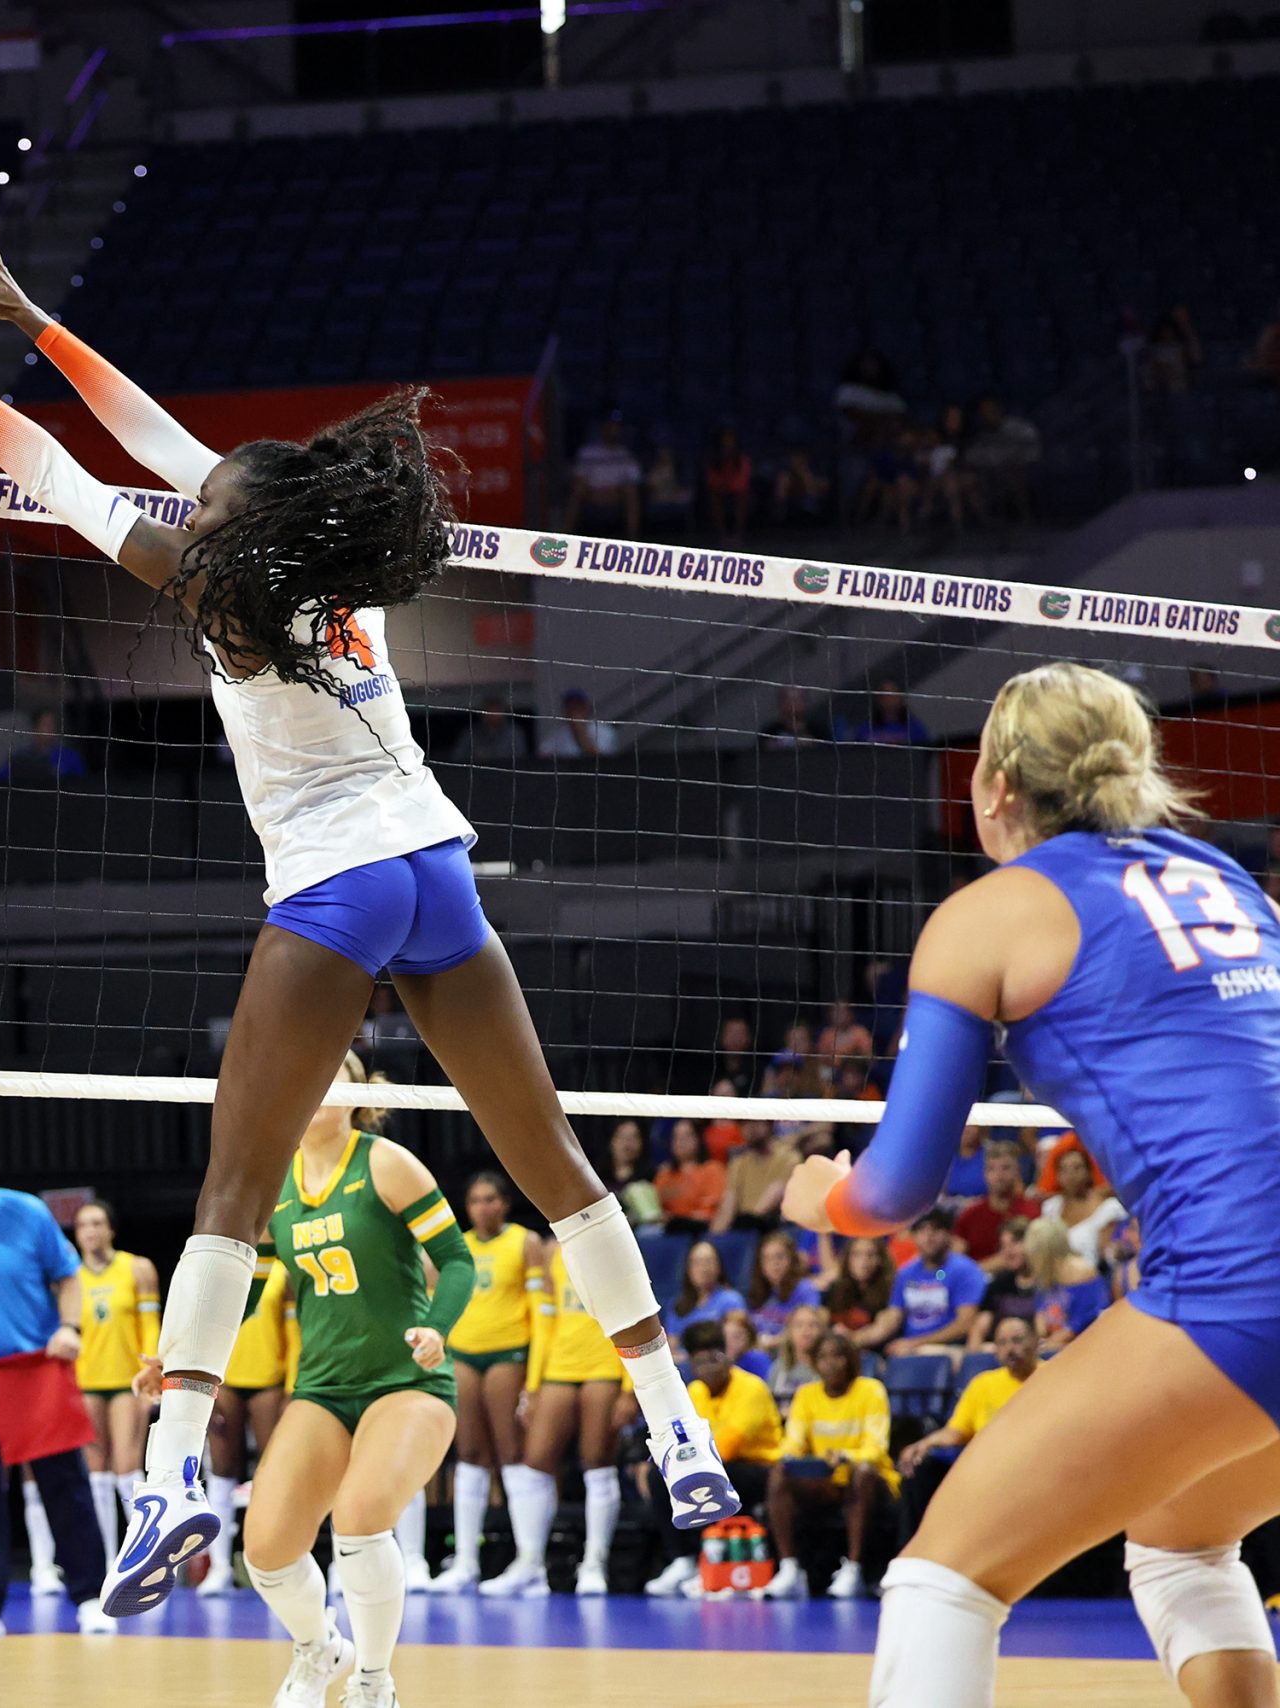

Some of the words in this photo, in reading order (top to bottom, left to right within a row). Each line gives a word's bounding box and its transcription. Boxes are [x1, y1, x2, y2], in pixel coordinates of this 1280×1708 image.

[575, 541, 674, 578] FLORIDA
[677, 552, 765, 587] GATORS
[836, 568, 926, 604] FLORIDA
[931, 580, 1013, 613] GATORS
[1077, 594, 1160, 628] FLORIDA
[1165, 604, 1241, 636] GATORS
[1122, 856, 1262, 973] 13
[292, 1212, 345, 1250] NSU
[294, 1246, 360, 1297] 19
